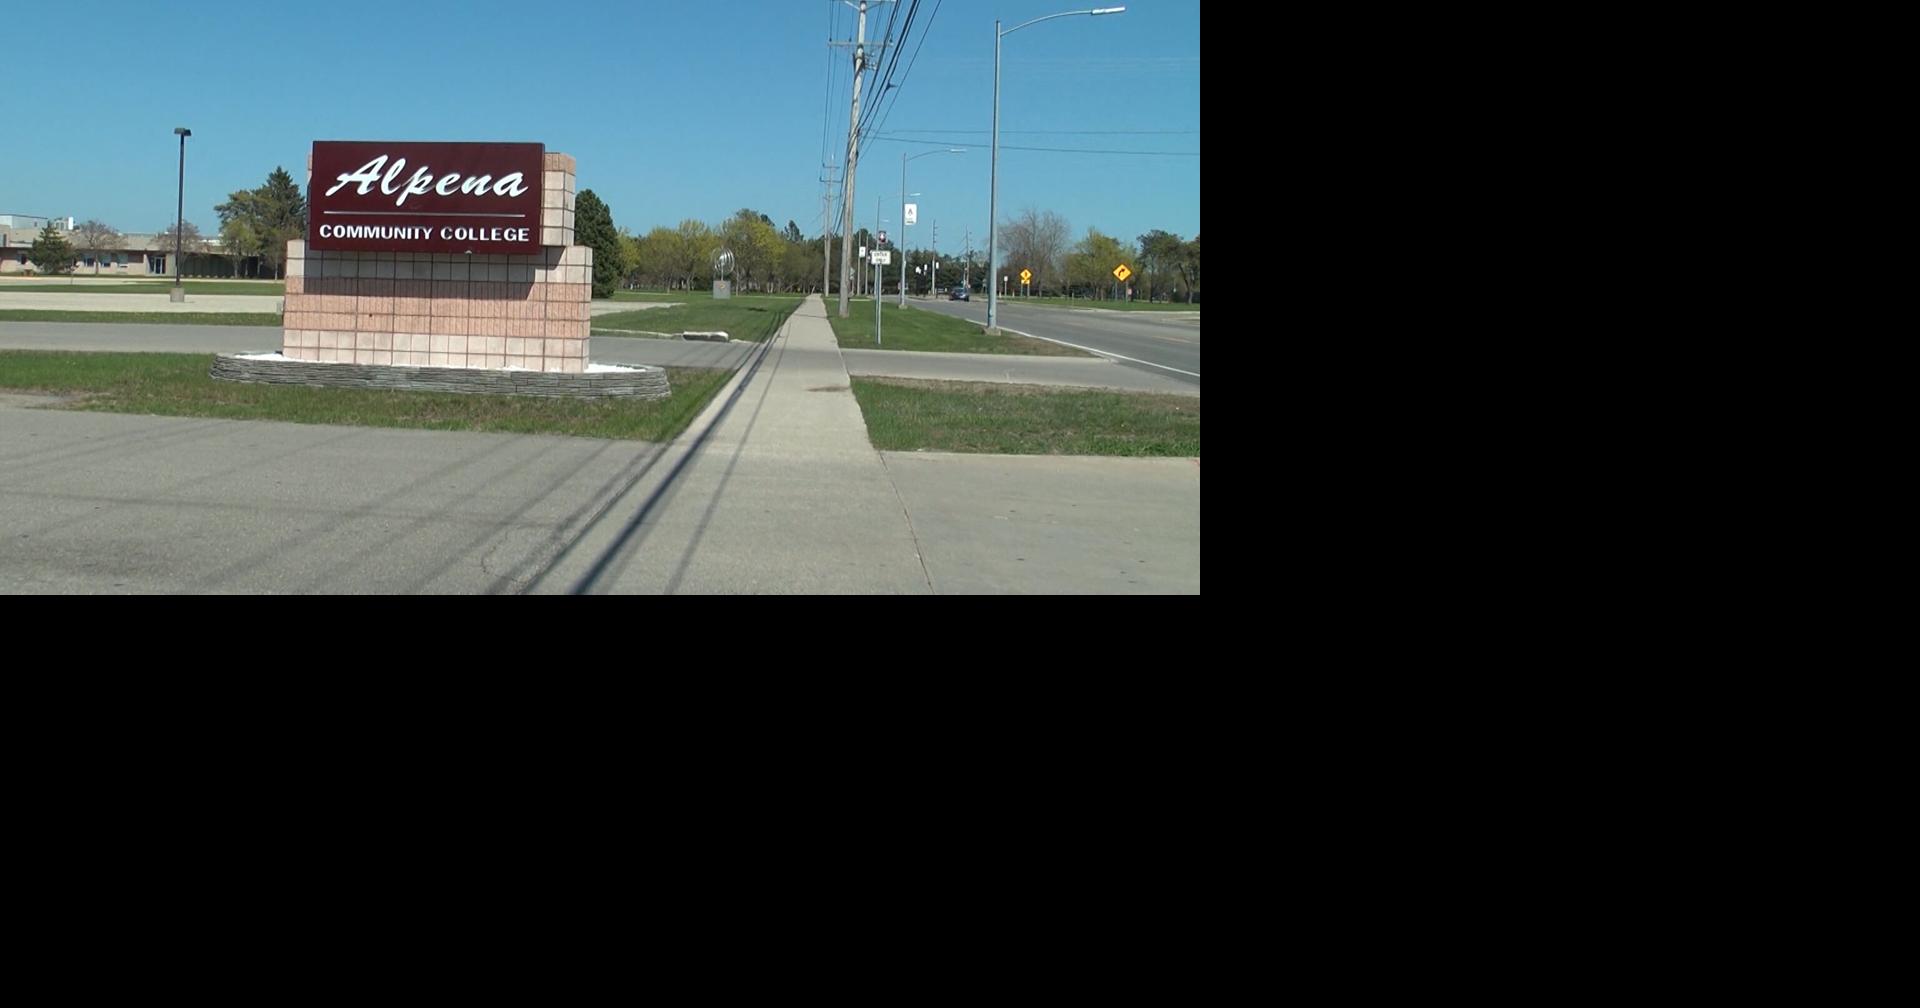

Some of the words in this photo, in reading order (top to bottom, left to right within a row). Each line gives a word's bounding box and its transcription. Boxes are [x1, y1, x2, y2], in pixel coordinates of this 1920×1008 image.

[325, 154, 529, 207] Alpena
[319, 224, 433, 240] COMMUNITY
[440, 225, 530, 242] COLLEGE
